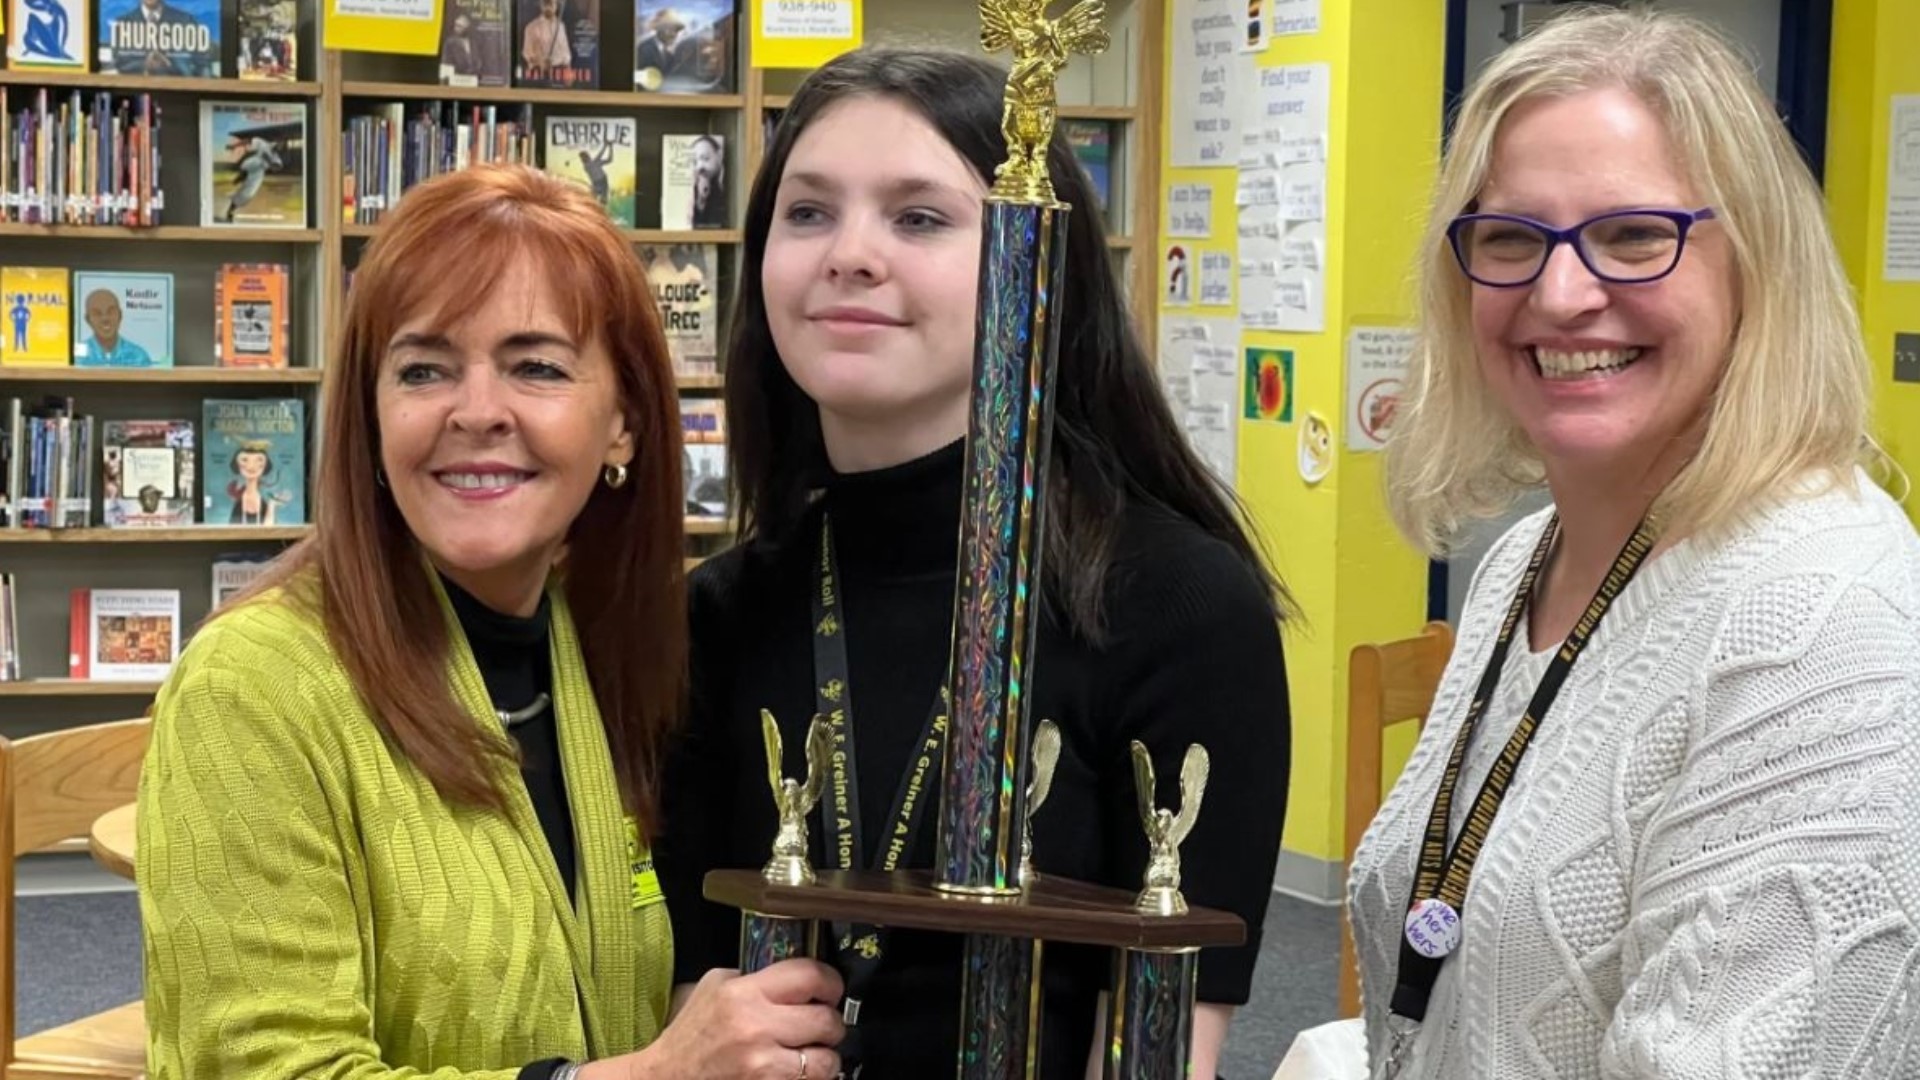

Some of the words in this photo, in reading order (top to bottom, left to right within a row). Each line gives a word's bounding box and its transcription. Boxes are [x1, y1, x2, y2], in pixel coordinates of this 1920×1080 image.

[109, 20, 211, 51] THURGOOD
[1195, 41, 1211, 57] but
[1213, 42, 1232, 59] you
[1261, 69, 1285, 87] Find
[1287, 70, 1311, 90] your
[1267, 100, 1304, 116] answer
[551, 120, 631, 147] CHARLIE
[1194, 118, 1217, 132] want
[1220, 118, 1231, 131] to
[125, 288, 159, 299] Kadir
[125, 301, 162, 310] Nelson
[661, 304, 700, 330] TREC
[822, 574, 835, 606] Roll
[1574, 595, 1608, 640] GREINER
[1601, 533, 1652, 598] EXPLORATOR
[923, 738, 939, 753] E.
[832, 750, 848, 814] Greiner
[900, 756, 930, 820] Greiner
[1457, 786, 1499, 861] EXPLORATORY
[1489, 759, 1513, 793] ARTS
[836, 817, 852, 832] A
[894, 821, 909, 835] A
[1420, 907, 1446, 935] her
[1407, 918, 1439, 956] hers
